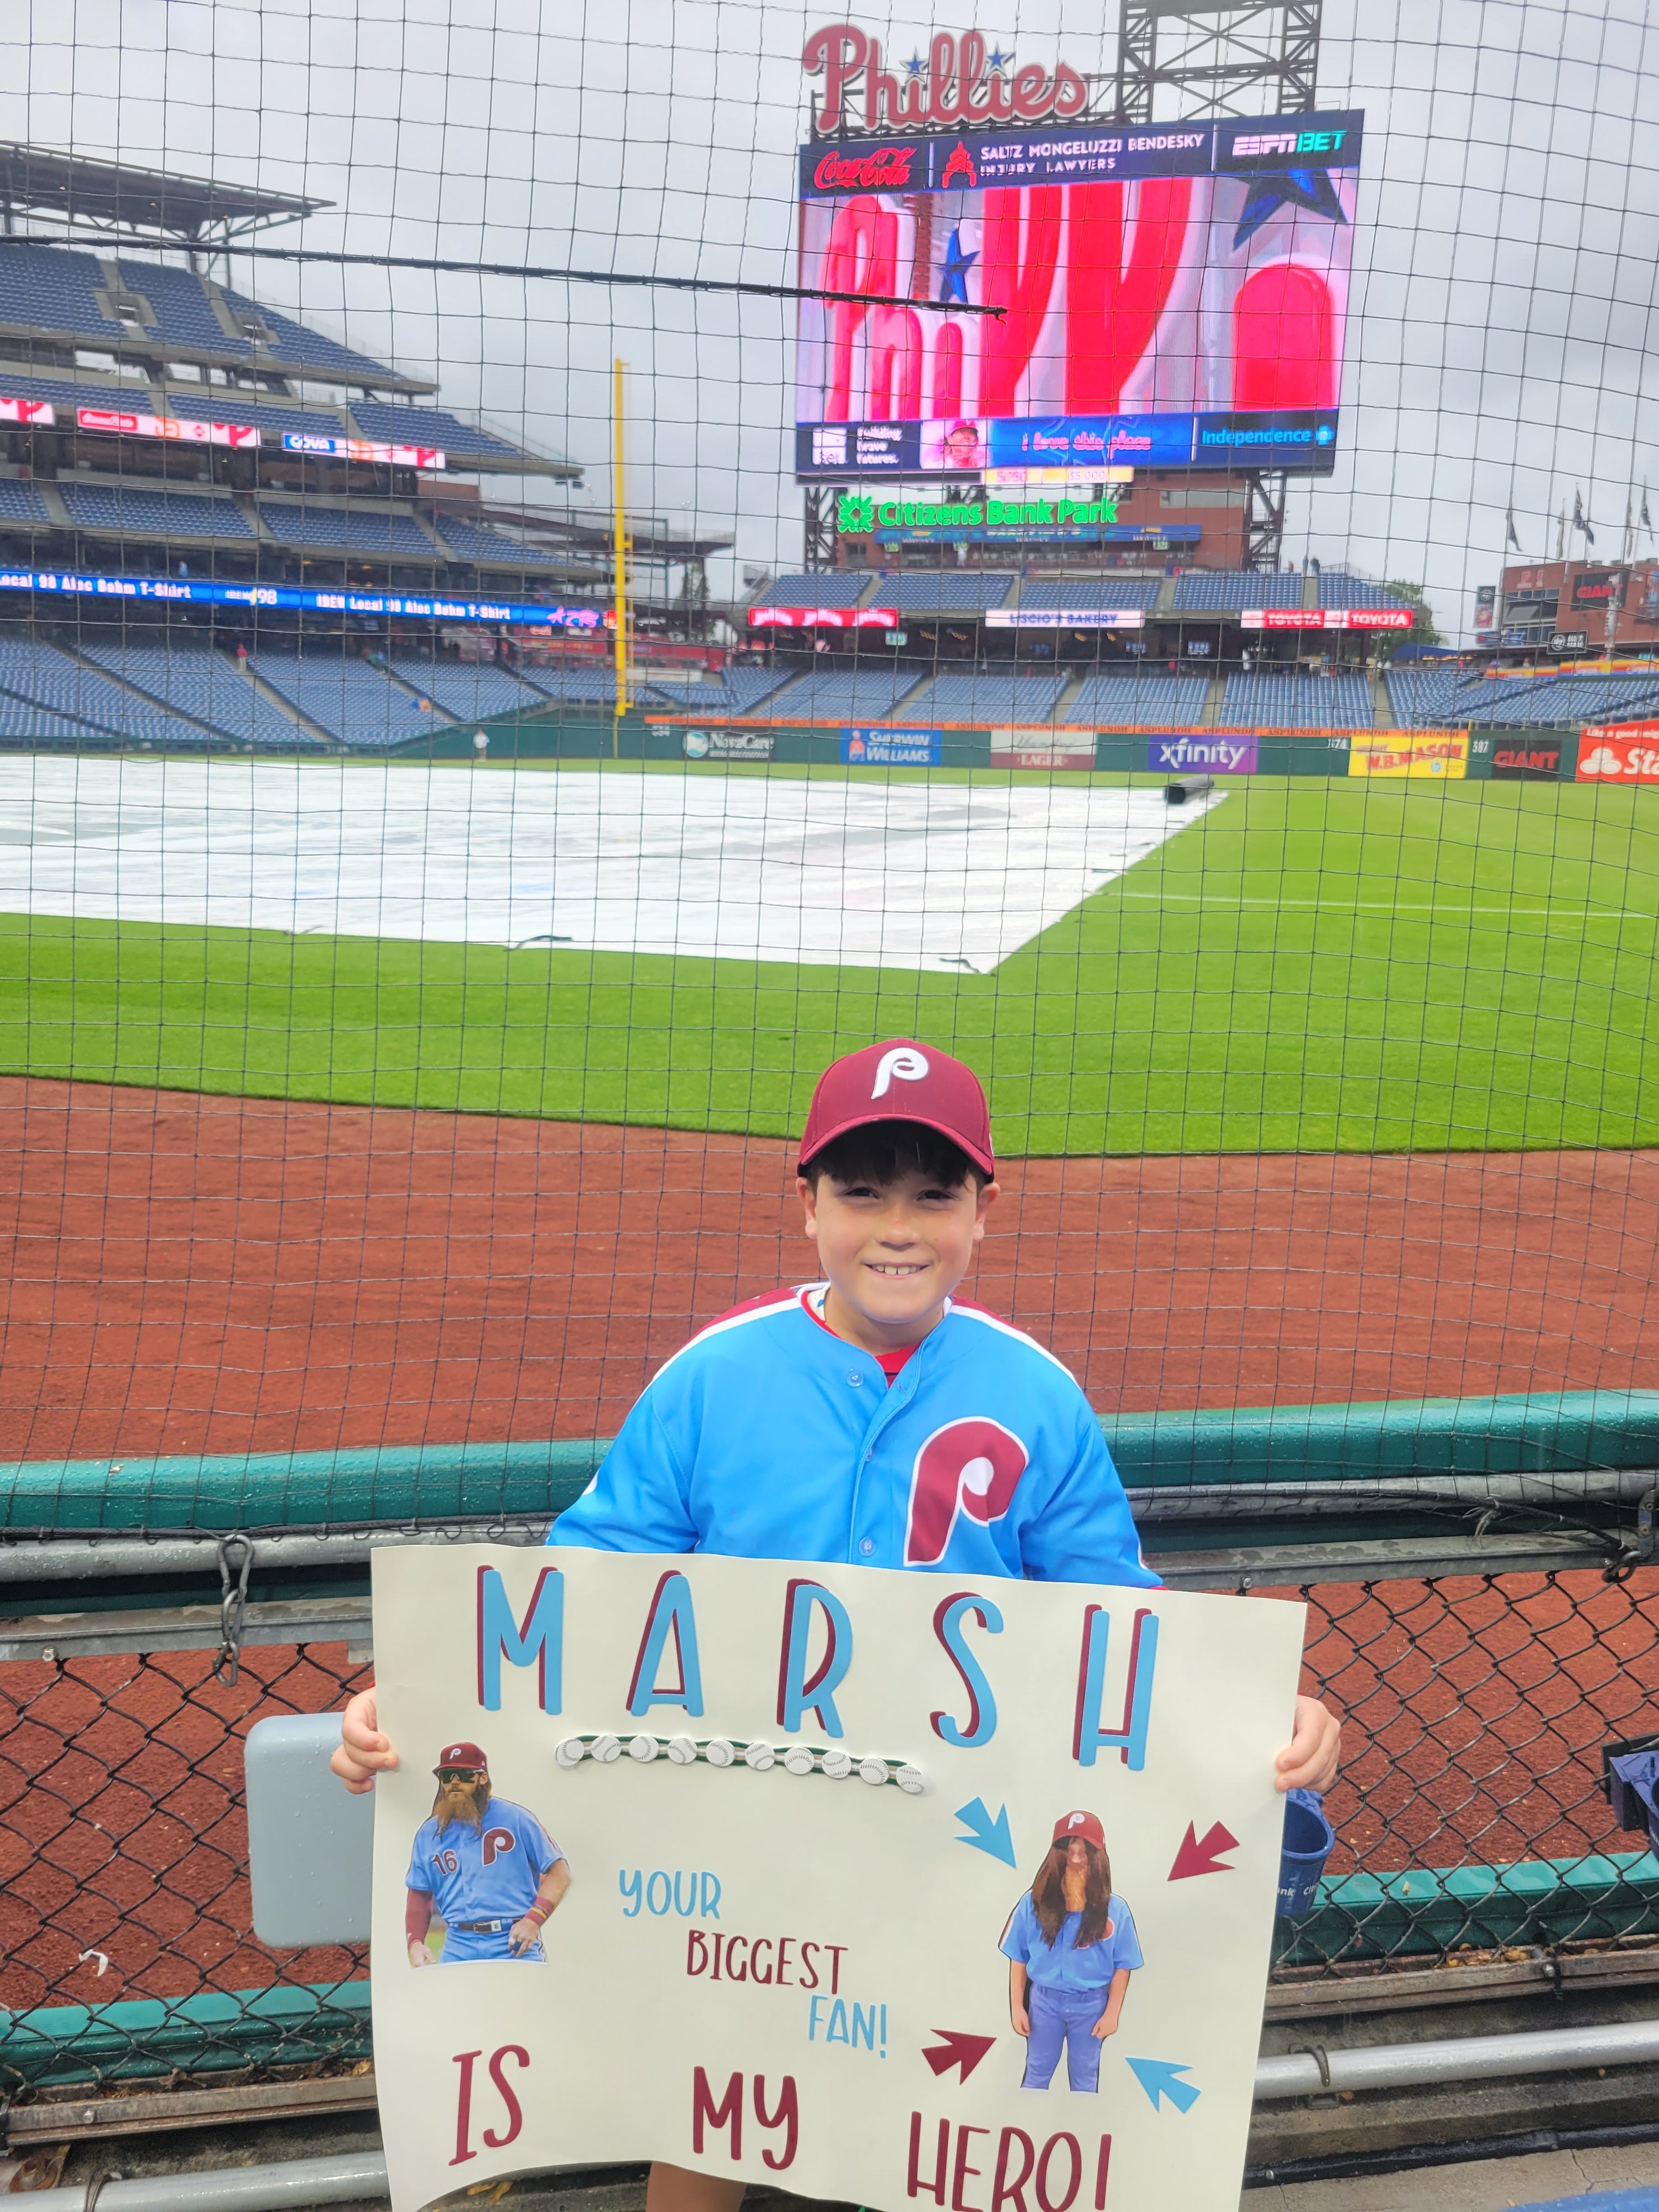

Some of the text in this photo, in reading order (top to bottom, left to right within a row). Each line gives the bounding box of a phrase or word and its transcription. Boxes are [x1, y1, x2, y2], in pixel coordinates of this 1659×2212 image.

[801, 22, 1089, 134] Phillies
[980, 134, 1205, 160] SALTZ MONGELUZZI BENDESKY
[814, 147, 917, 189] Coca-Cola
[980, 158, 1116, 176] INJURY LAWYERS
[1107, 429, 1152, 460] place
[1202, 427, 1312, 447] Independence
[878, 497, 1118, 526] Citizens Bank Park
[0, 573, 32, 587] ocal
[257, 588, 278, 604] 98
[1067, 613, 1118, 624] BAKERY
[1267, 613, 1322, 626] TOYOTA
[1351, 613, 1406, 626] TOYOTA
[867, 747, 930, 762] WILLIAMS
[1020, 754, 1063, 766] LAGER
[1159, 737, 1248, 770] xfinity
[1494, 750, 1559, 769] GIANT
[871, 1047, 929, 1099] P
[904, 1415, 1030, 1567] P
[477, 1565, 1159, 1771] MARSH
[482, 1827, 515, 1866] P
[431, 1849, 458, 1876] 16
[619, 1869, 722, 1919] YOUR
[686, 1929, 849, 1995] BIGGEST
[808, 1995, 887, 2059] FAN!
[448, 2044, 530, 2166] IS
[692, 2065, 799, 2171] MY
